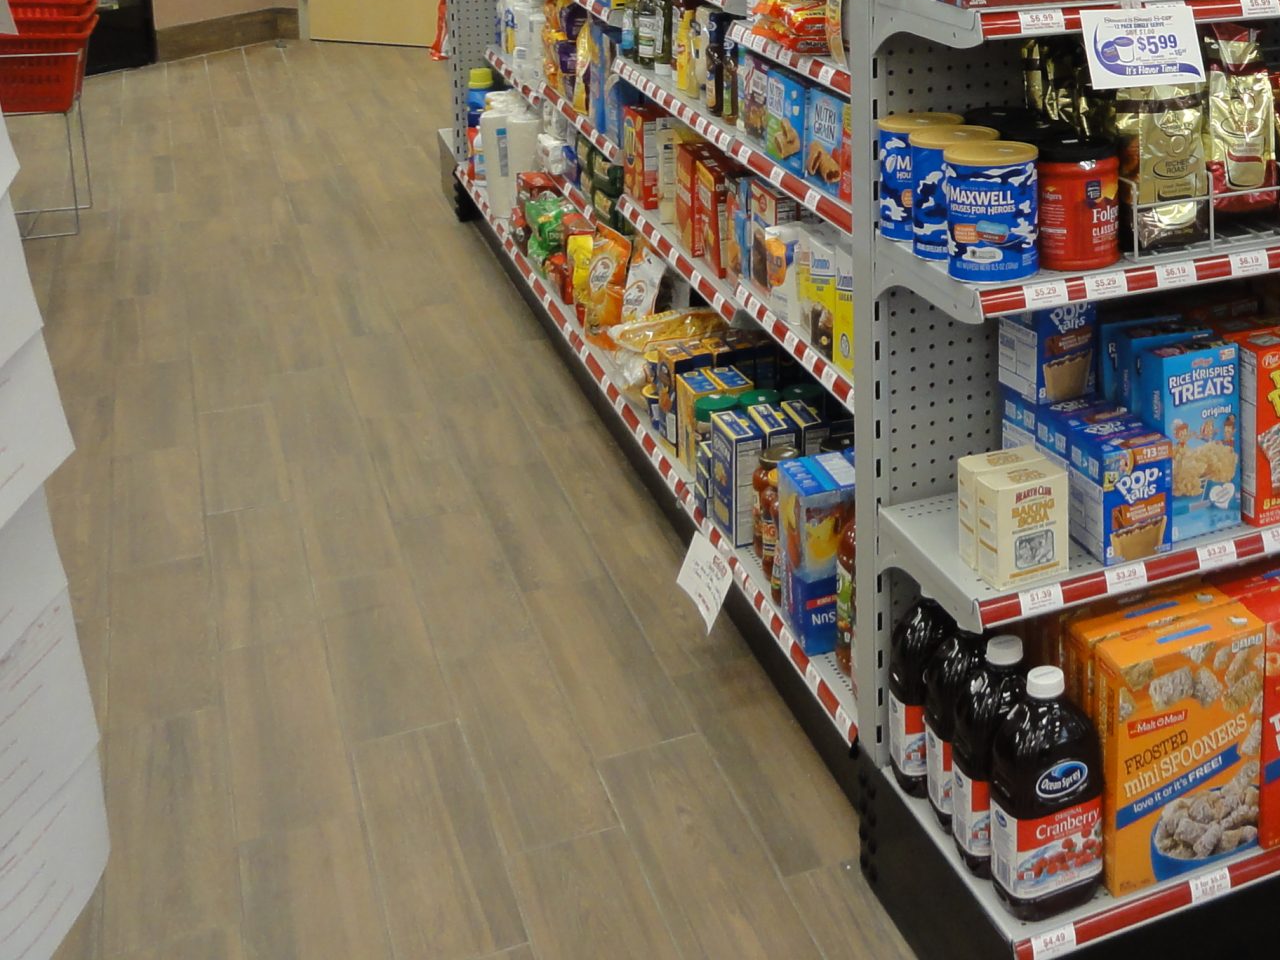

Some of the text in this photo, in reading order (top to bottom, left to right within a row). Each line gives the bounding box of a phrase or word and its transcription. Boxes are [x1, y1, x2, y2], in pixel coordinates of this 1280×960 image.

[815, 103, 837, 124] NUTRI
[813, 120, 836, 141] GRAIN
[949, 185, 1015, 205] MAXWELL
[971, 204, 986, 214] FOR
[987, 203, 1016, 215] HEROES
[1168, 363, 1235, 389] RICE KRISPIES
[1170, 376, 1235, 407] TREATS
[1011, 498, 1055, 520] BAKING
[1017, 510, 1050, 529] SODA
[1106, 547, 1115, 557] 8
[1124, 729, 1189, 775] FROSTED
[1124, 712, 1248, 798] mini SPOONERS
[1041, 769, 1081, 791] Ocean Spray
[1133, 755, 1222, 814] love it or it's FREE!
[1035, 808, 1100, 840] Cranberry
